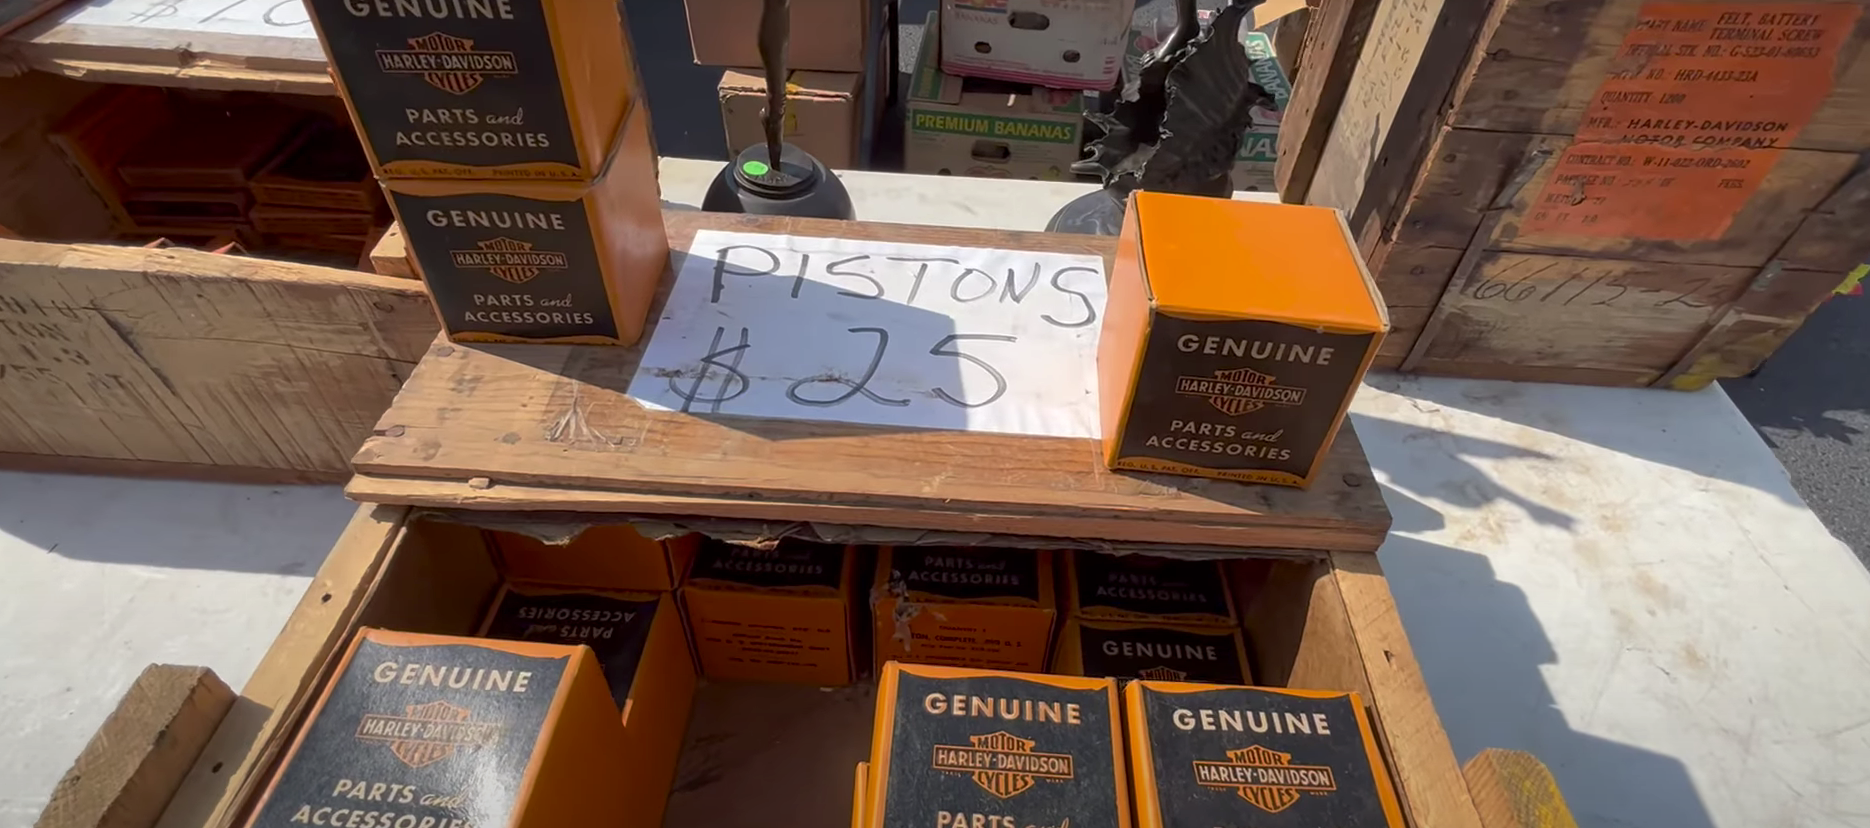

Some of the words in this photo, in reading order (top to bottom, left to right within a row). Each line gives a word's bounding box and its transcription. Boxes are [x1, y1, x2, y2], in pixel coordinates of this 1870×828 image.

[344, 0, 515, 20] GENUINE
[1758, 12, 1821, 26] BATTERY
[415, 33, 467, 51] MOTOR
[1709, 27, 1774, 41] TERMINAL
[1778, 29, 1825, 42] SCREW
[381, 53, 514, 70] HARLEY-DAVIDSON
[428, 72, 479, 93] CYCLES
[405, 108, 479, 124] PARTS
[486, 107, 524, 125] and
[1627, 118, 1788, 132] HARLEY-DAVIDSON
[916, 113, 990, 133] PREMIUM
[994, 120, 1072, 140] BANANAS
[396, 131, 550, 148] ACCESSORIES
[1692, 135, 1779, 149] COMPANY
[426, 209, 566, 230] GENUINE
[484, 238, 527, 251] MOTOR
[455, 252, 564, 266] HARLEY-DAVIDSON
[494, 266, 536, 283] CYCLES
[710, 245, 1100, 329] PISTONS
[473, 294, 534, 307] PARTS
[540, 293, 573, 308] and
[464, 311, 594, 325] ACCESSORIES
[1176, 334, 1335, 366] GENUINE
[1219, 369, 1268, 385] MOTOR
[1179, 379, 1302, 403] HARLEY-DAVIDSON
[1212, 396, 1264, 414] CYCLES
[1170, 420, 1237, 439] PARTS
[1241, 428, 1284, 443] and
[1145, 435, 1292, 461] ACCESSORIES
[711, 559, 824, 575] ACCESSORIES
[924, 555, 975, 569] PARTS
[908, 570, 1020, 586] ACCESSORIES
[1096, 585, 1208, 603] ACCESSORIES
[517, 606, 638, 624] ACCESSORIES
[560, 625, 615, 640] PARTS
[1102, 640, 1218, 661] GENUINE
[373, 661, 533, 693] GENUINE
[925, 692, 1082, 724] GENUINE
[1172, 708, 1331, 735] GENUINE
[977, 732, 1027, 752] MOTOR
[938, 749, 1069, 774] HARLEY-DAVIDSON
[1233, 747, 1284, 766] MOTOR
[977, 771, 1030, 796] CYCLES
[1198, 765, 1331, 787] HARLEY-DAVIDSON
[331, 778, 416, 804] PARTS
[419, 784, 468, 808] and
[1242, 786, 1296, 811] CYCLES
[937, 810, 1015, 828] PARTS
